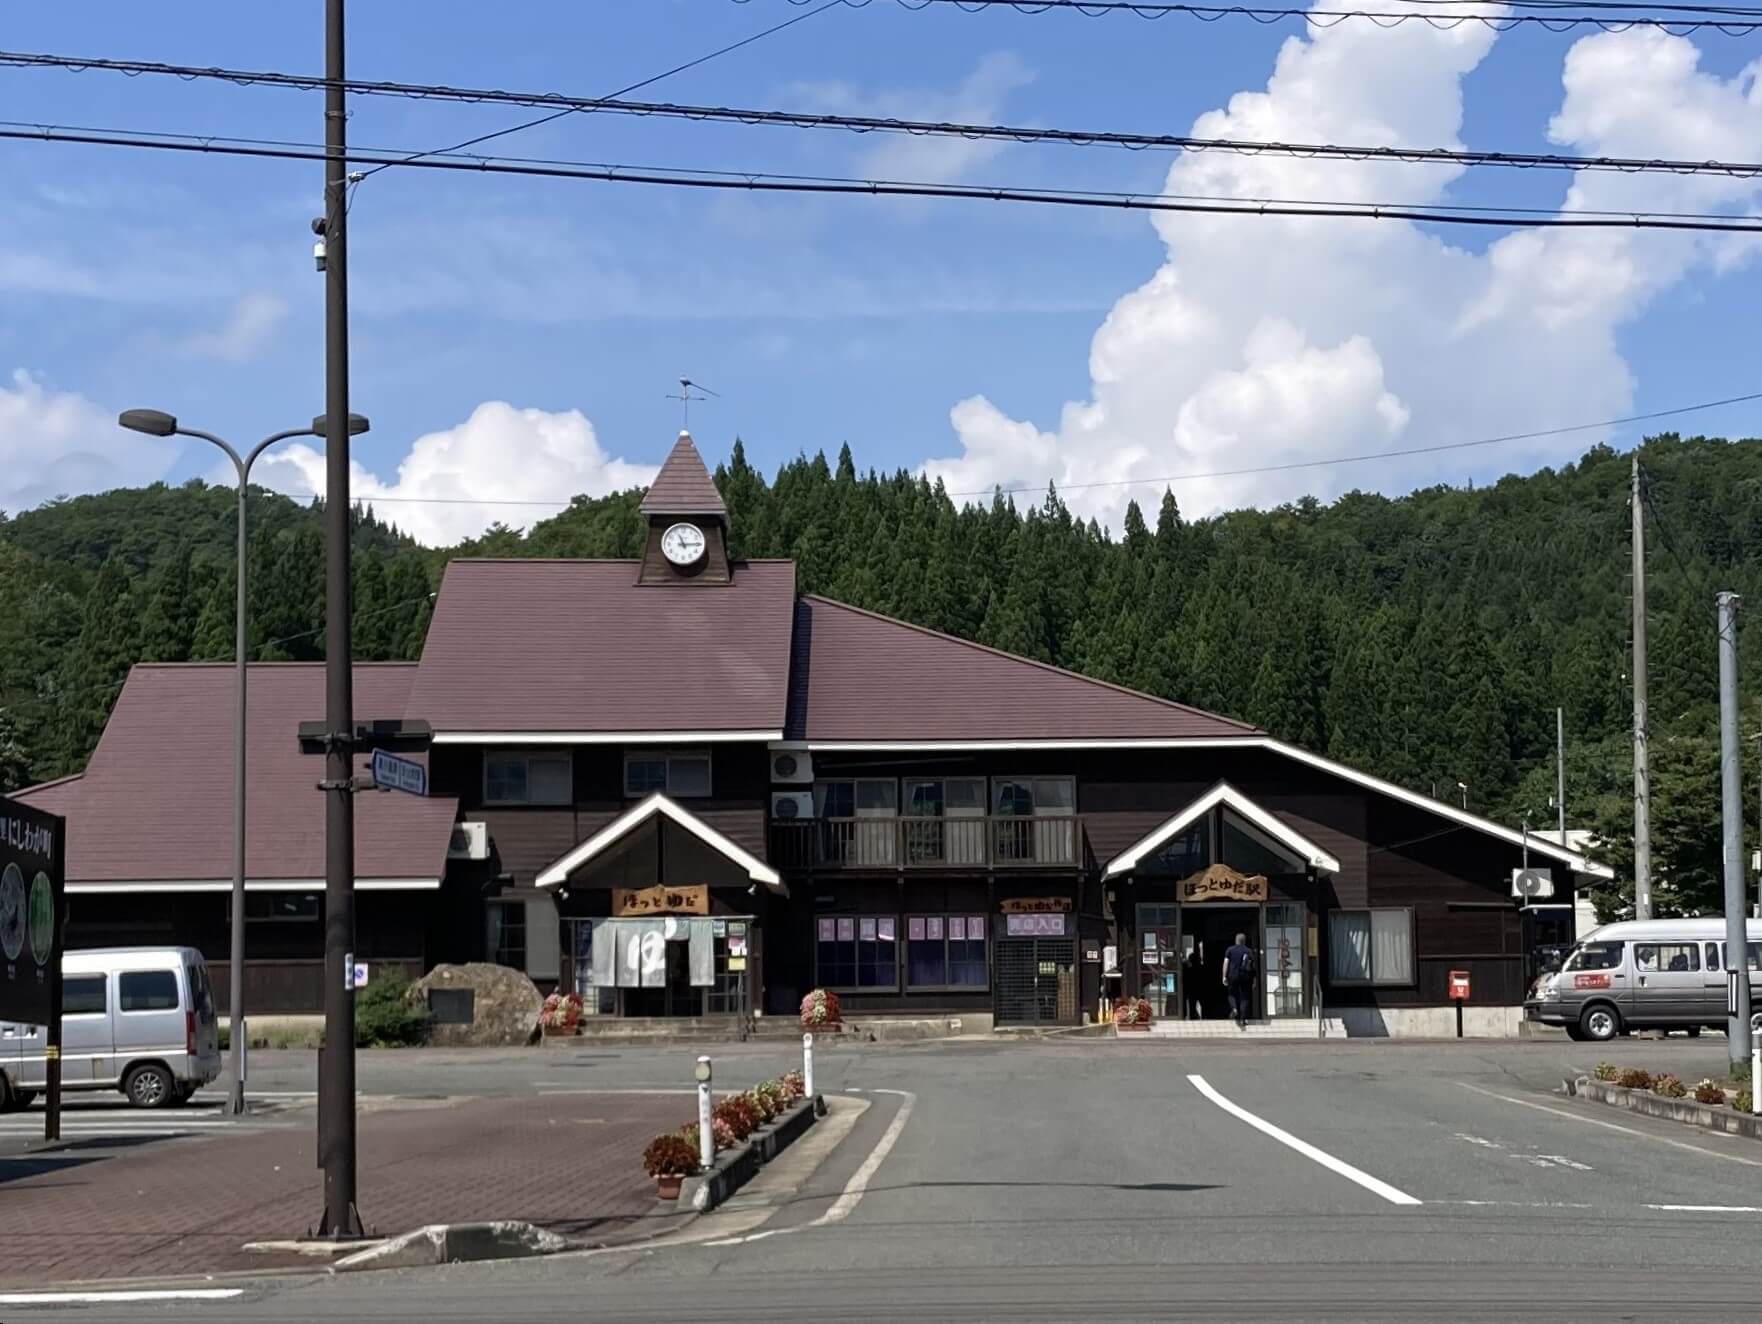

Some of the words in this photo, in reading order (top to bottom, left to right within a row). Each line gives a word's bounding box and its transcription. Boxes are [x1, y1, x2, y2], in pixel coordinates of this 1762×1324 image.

[1184, 878, 1261, 896] ほっとゆだ駅
[623, 893, 699, 909] ほっとゆだ
